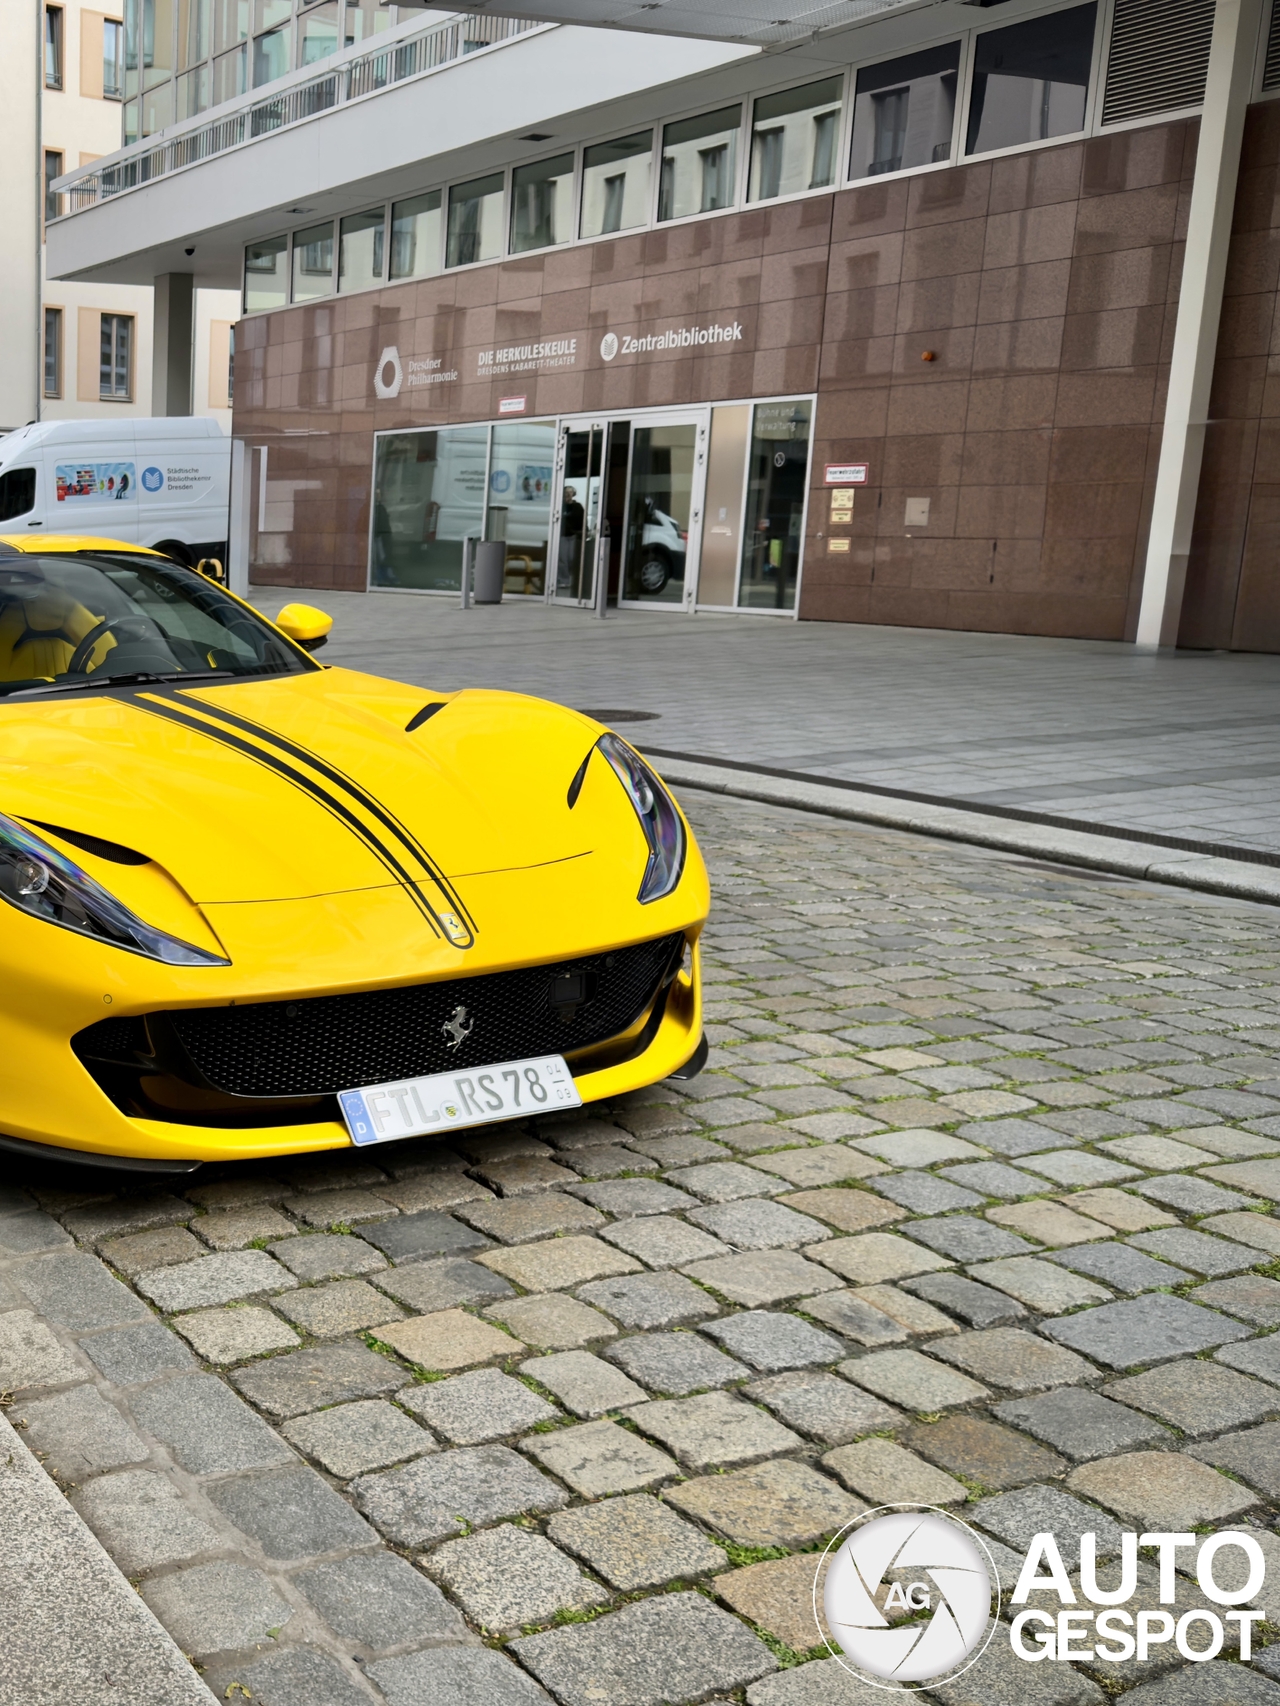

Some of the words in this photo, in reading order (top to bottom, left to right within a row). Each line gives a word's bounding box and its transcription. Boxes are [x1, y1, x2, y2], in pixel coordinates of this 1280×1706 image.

[621, 321, 743, 354] Zentralbibliothek
[478, 350, 494, 366] DIE
[495, 339, 577, 363] HERKULESKEULE
[408, 358, 442, 372] Dresdner
[477, 365, 509, 377] DRESDENS
[510, 356, 576, 372] KABARETT-THEATER
[407, 369, 458, 386] Philharmonie
[167, 467, 200, 475] Städtische
[167, 483, 194, 491] Dresden
[546, 1064, 562, 1076] 04
[556, 1088, 572, 1100] 09
[365, 1086, 441, 1133] FTL
[357, 1122, 367, 1134] D
